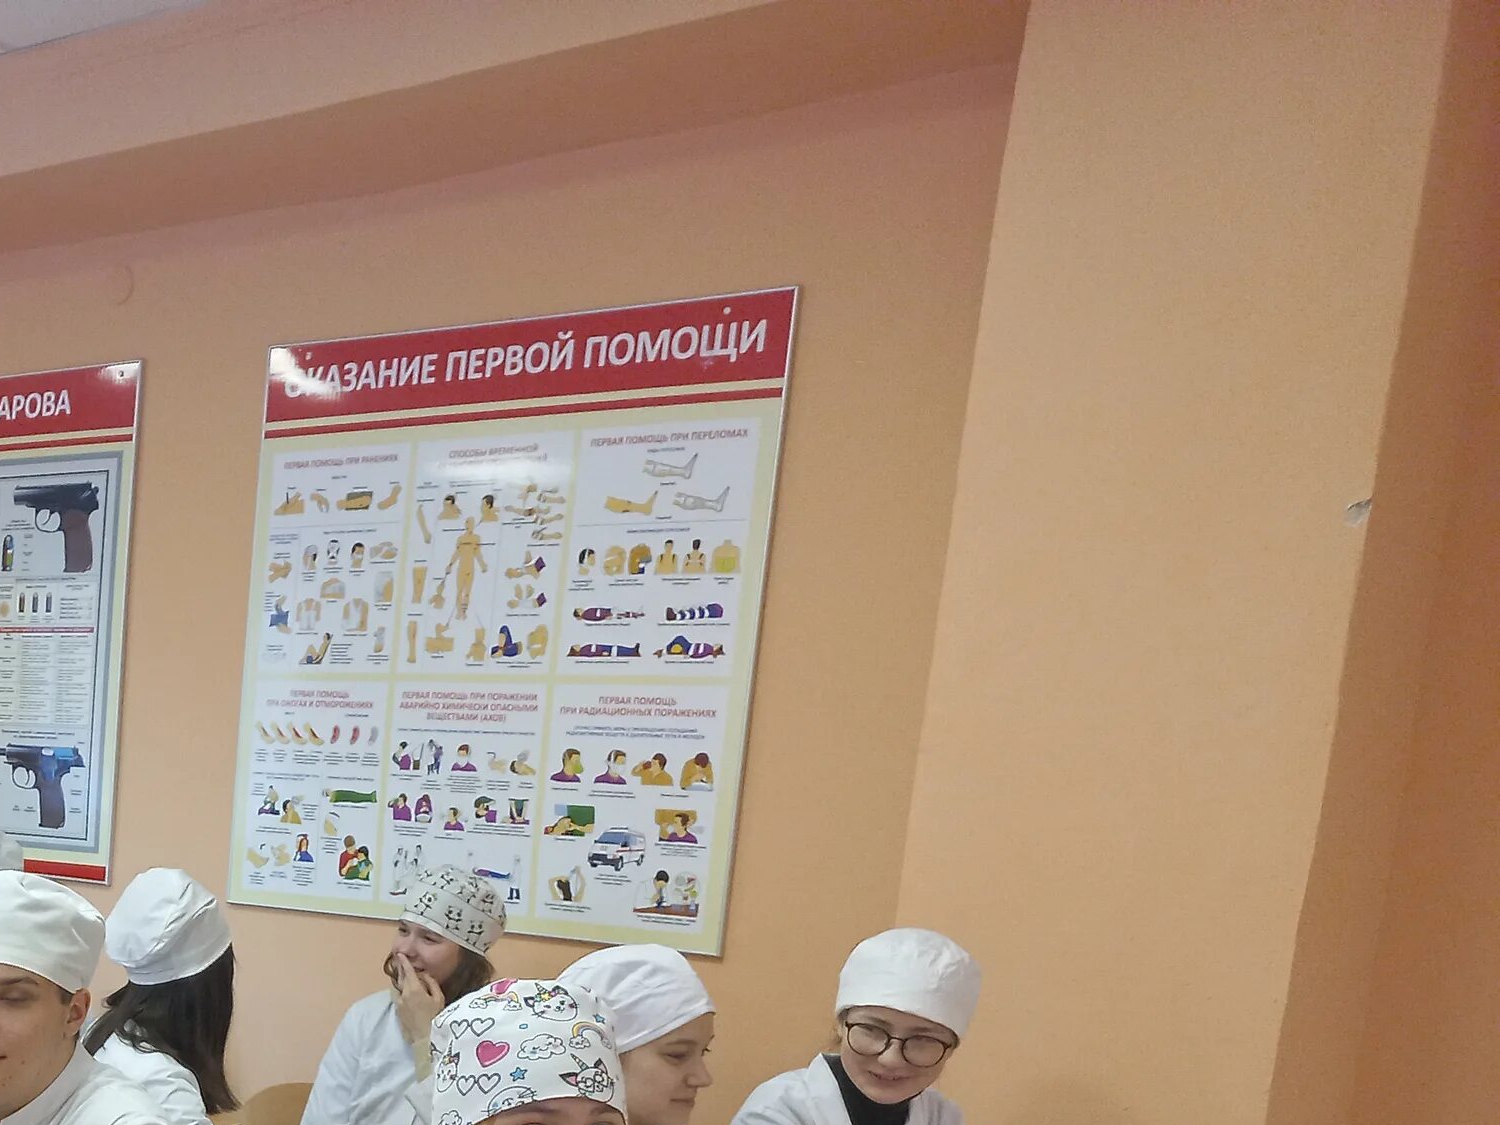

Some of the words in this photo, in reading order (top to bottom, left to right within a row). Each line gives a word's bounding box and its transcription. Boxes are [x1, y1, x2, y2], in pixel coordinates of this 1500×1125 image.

[445, 331, 576, 381] ПЕРВОЙ
[583, 319, 768, 369] ПОМОЩИ
[590, 436, 625, 447] ПЕРВАЯ
[626, 434, 668, 446] ПОМОЩЬ
[670, 432, 689, 441] ПРИ
[691, 428, 748, 440] ПЕРЕЛОМАХ
[598, 696, 631, 705] ПЕРВАЯ
[633, 697, 677, 707] ПОМОЩЬ
[560, 706, 577, 714] ПРИ
[578, 707, 652, 717] РАДИАЦИОННЫХ
[654, 708, 717, 718] ПОРАЖЕНИЯХ
